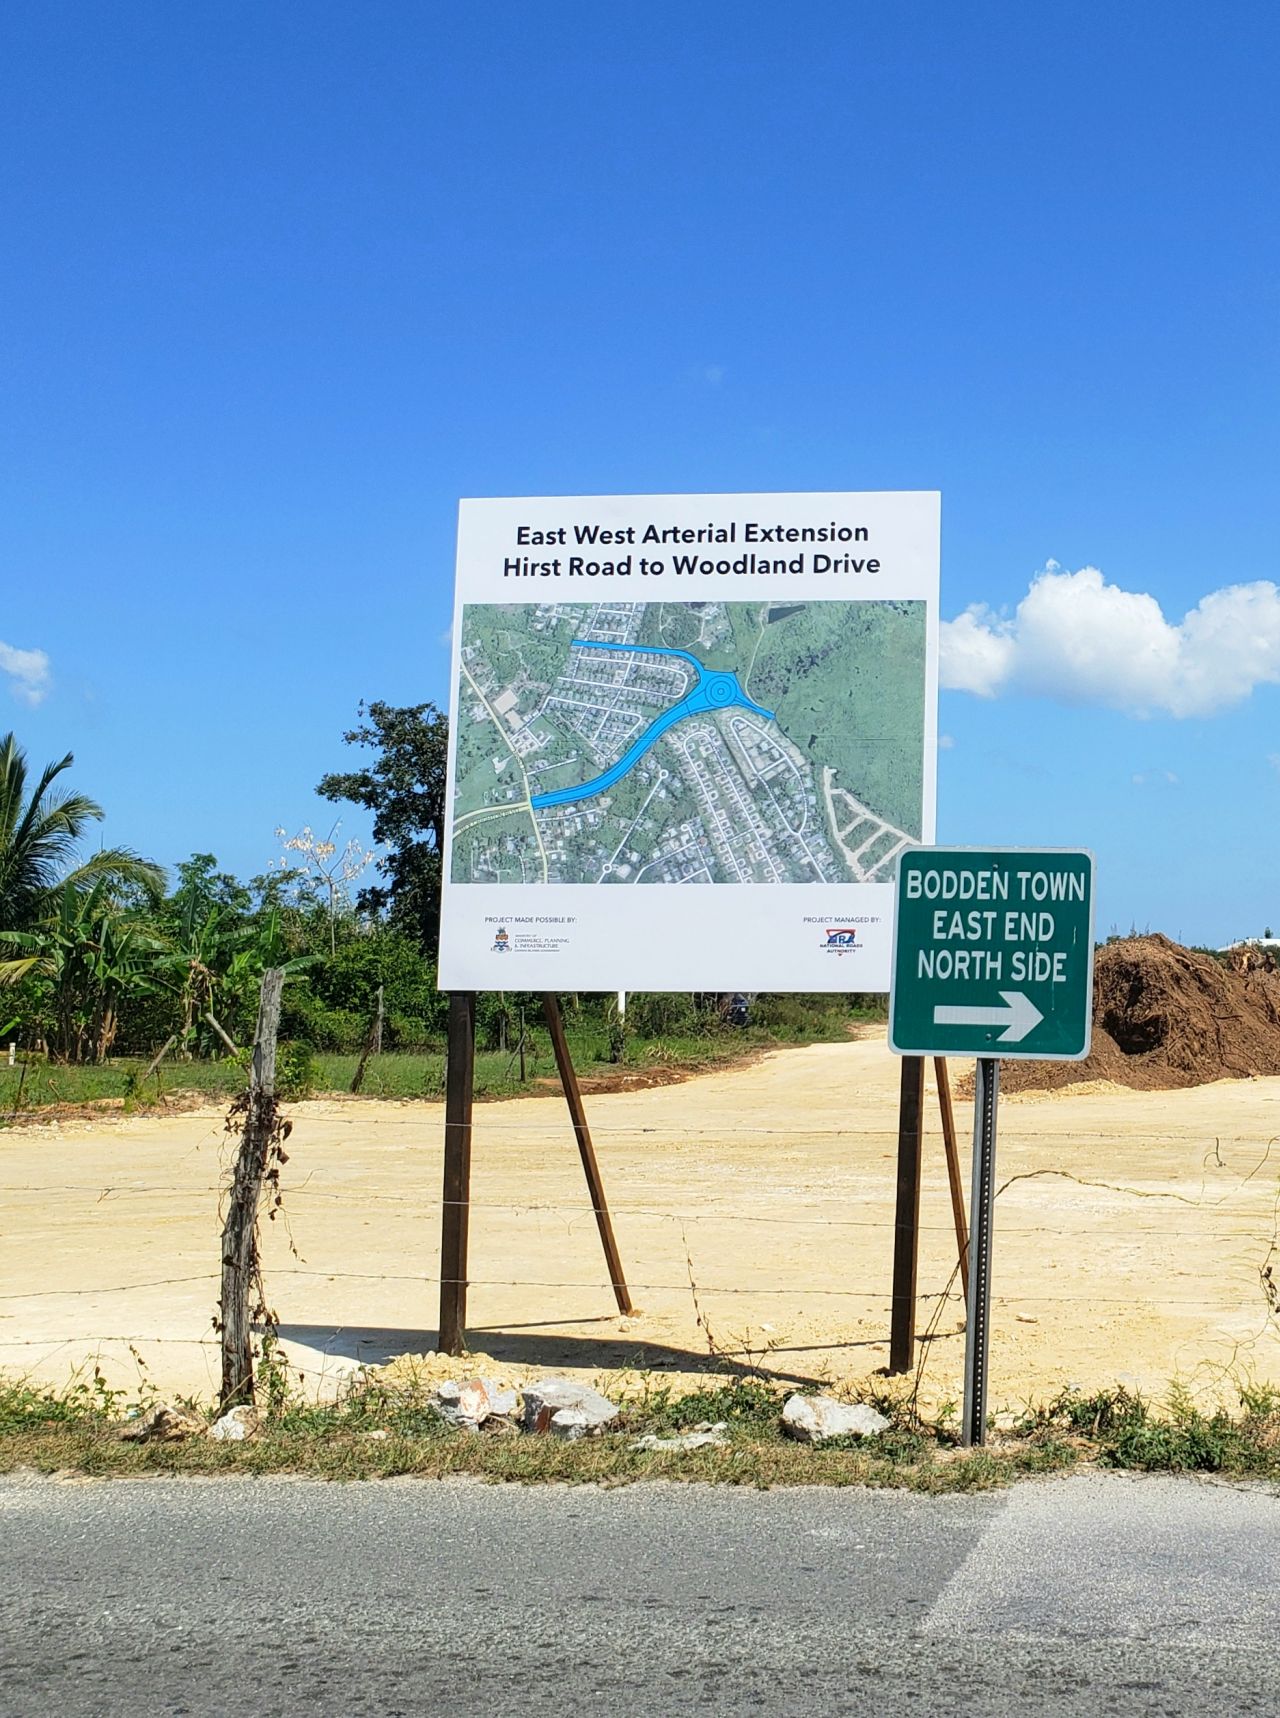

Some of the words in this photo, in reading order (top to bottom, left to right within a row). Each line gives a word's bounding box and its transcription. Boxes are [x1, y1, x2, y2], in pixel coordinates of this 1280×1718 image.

[517, 526, 567, 546] East
[573, 525, 635, 545] West
[641, 522, 736, 544] Arterial
[744, 521, 869, 543] Extension
[503, 556, 561, 577] Hirst
[569, 555, 632, 576] Road
[639, 558, 665, 576] to
[672, 553, 804, 575] Woodland
[813, 553, 881, 574] Drive
[906, 869, 1009, 900] BODDEN
[1016, 871, 1085, 901] TOWN
[484, 916, 513, 924] PROJECT
[515, 916, 534, 924] MADE
[535, 916, 565, 924] POSSIBLE
[566, 916, 578, 924] BY:
[803, 916, 833, 924] PROJECT
[834, 916, 870, 924] MANAGED
[870, 916, 882, 924] BY:
[932, 910, 998, 940] EAST
[1004, 911, 1055, 942] END
[917, 949, 1002, 980] NORTH
[1010, 951, 1067, 982] SIDE
